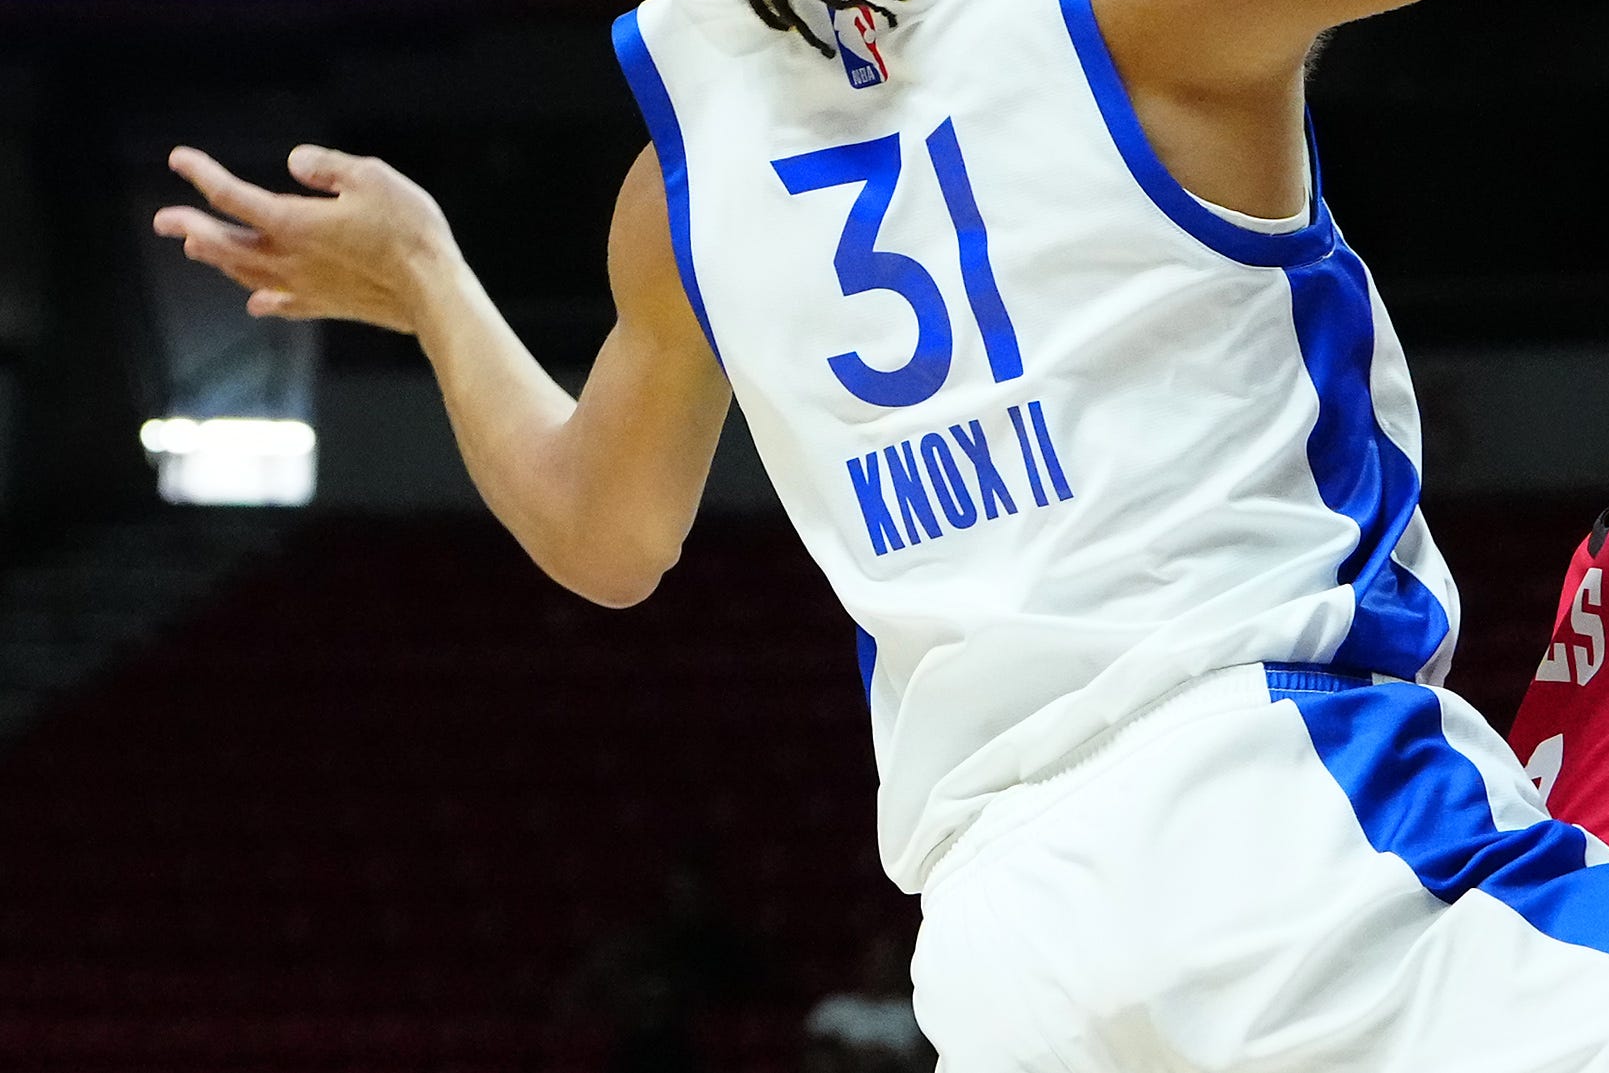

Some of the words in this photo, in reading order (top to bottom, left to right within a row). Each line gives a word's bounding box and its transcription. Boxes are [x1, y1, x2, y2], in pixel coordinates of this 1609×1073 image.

[851, 65, 876, 86] NBA
[770, 115, 1024, 409] 31
[846, 419, 1018, 556] KNOX
[1007, 400, 1074, 507] II
